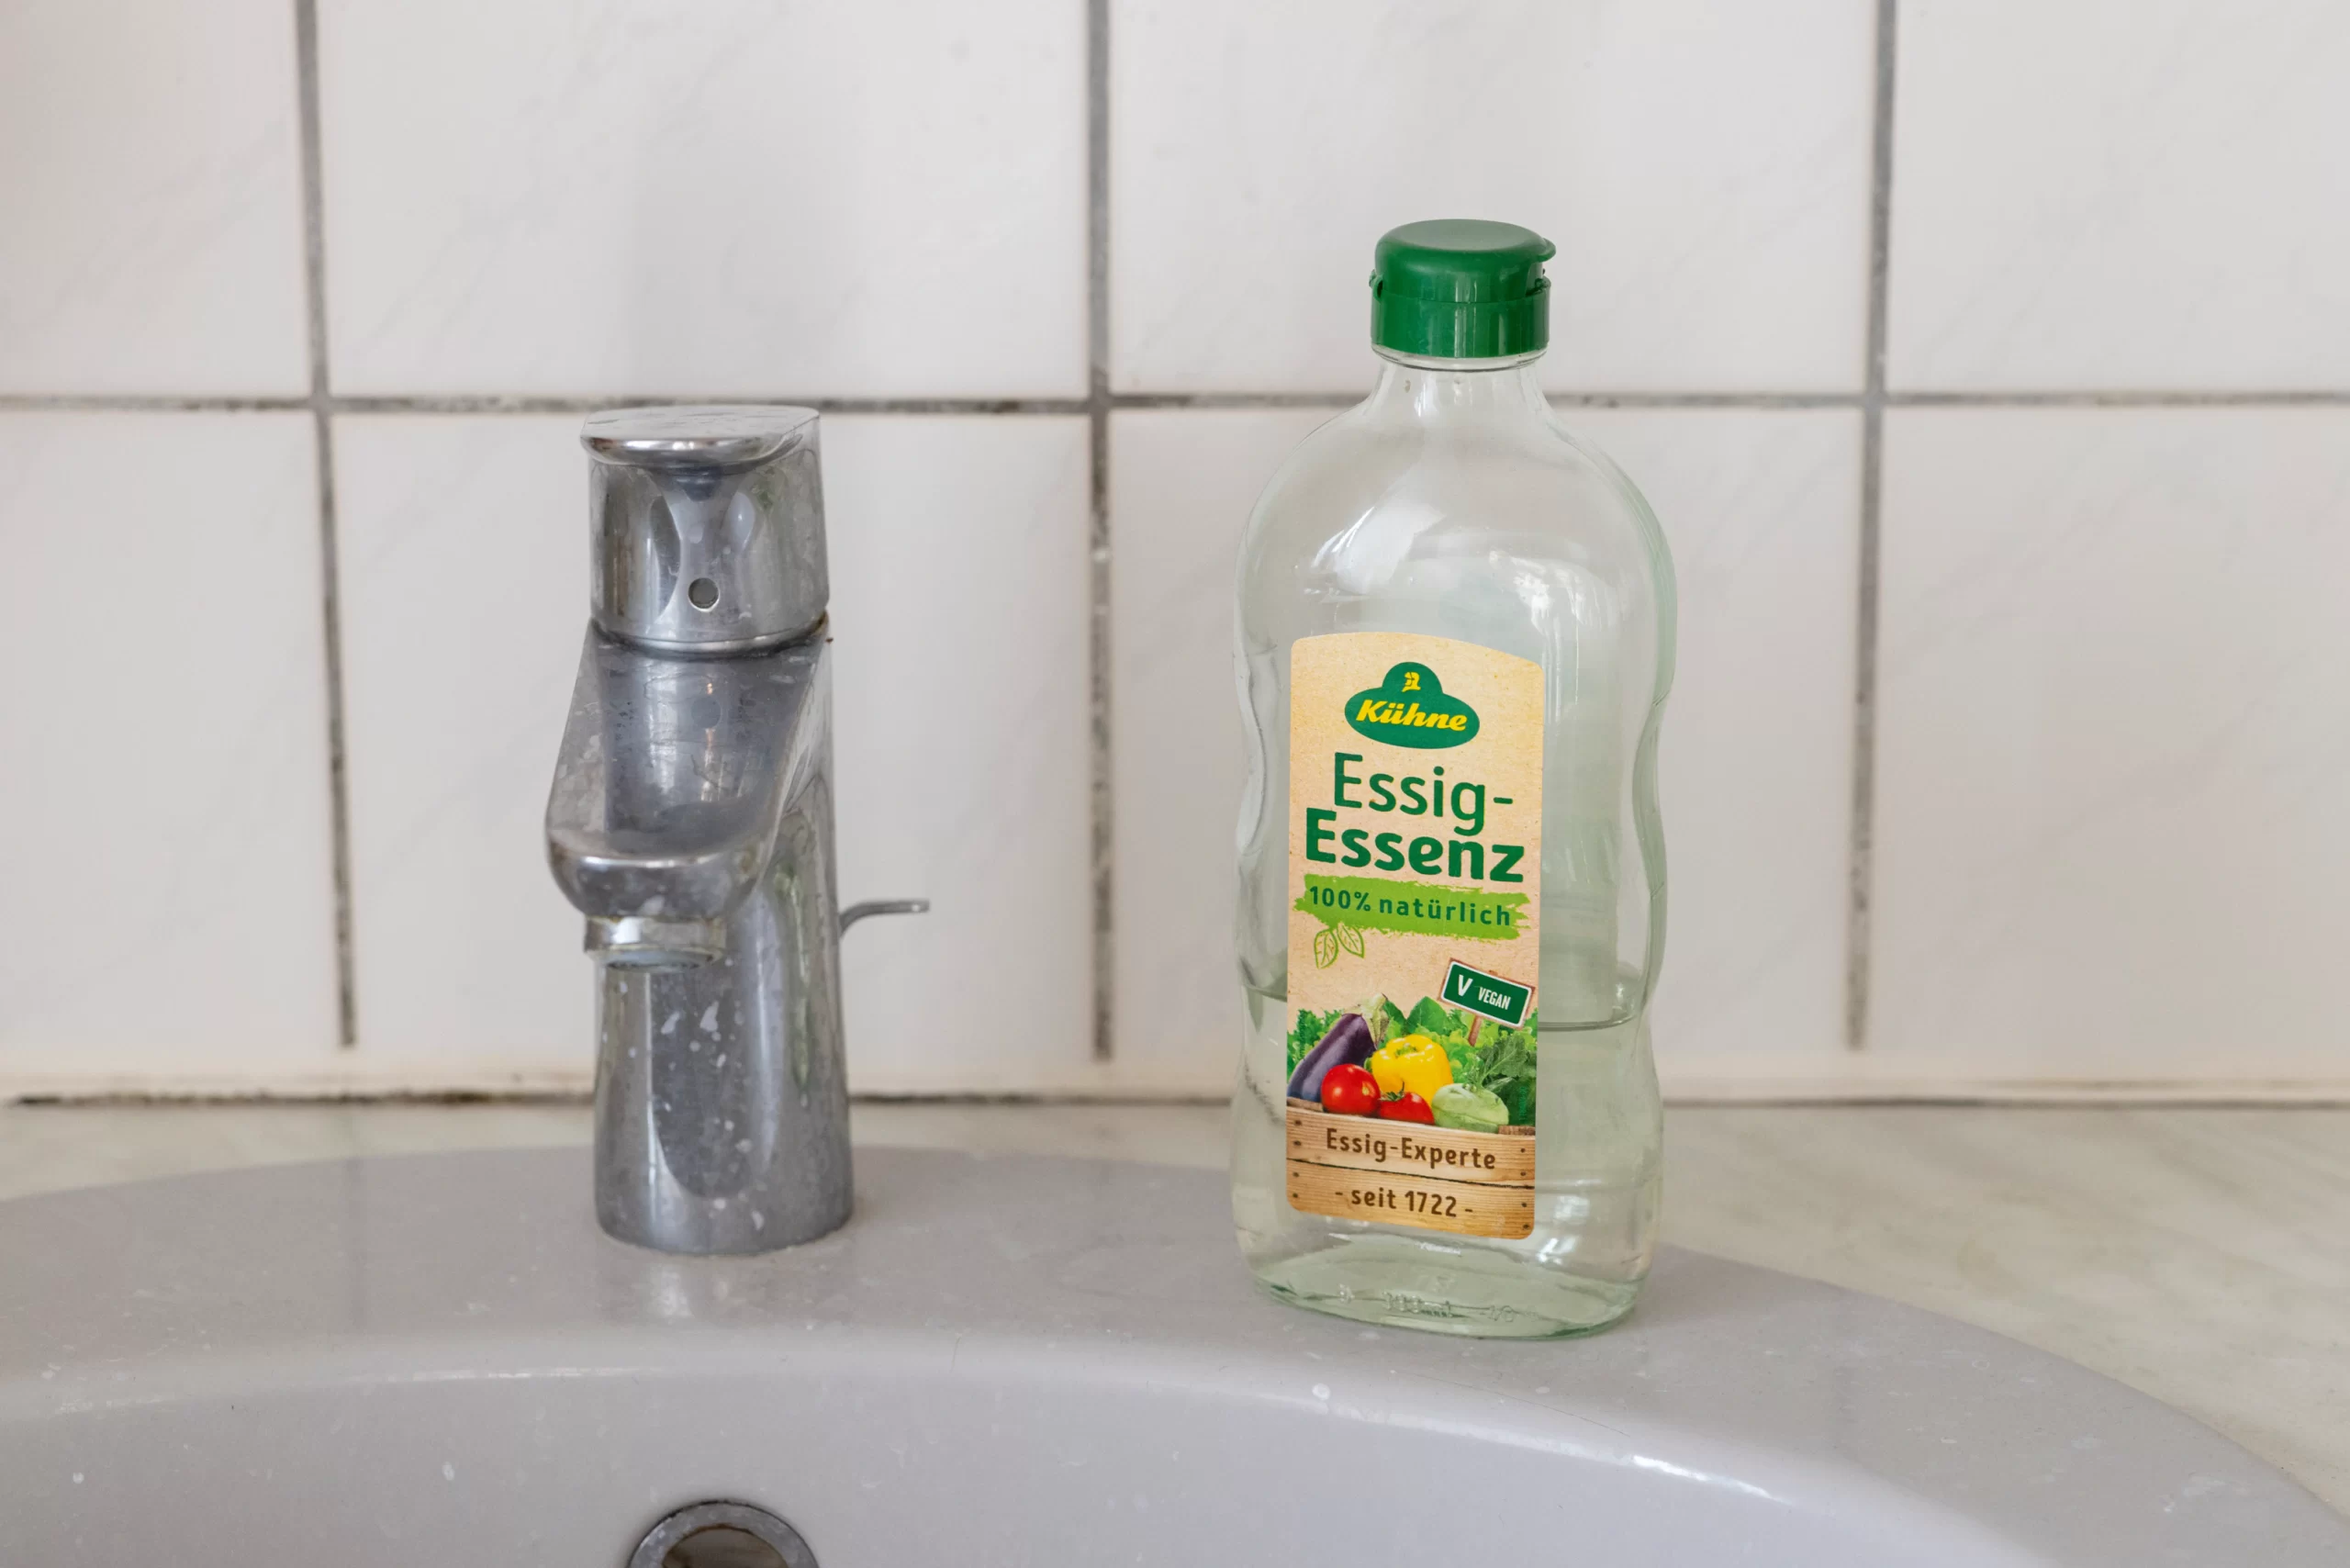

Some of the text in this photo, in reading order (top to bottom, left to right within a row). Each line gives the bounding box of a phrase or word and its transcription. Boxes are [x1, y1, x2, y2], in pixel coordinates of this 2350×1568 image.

[1355, 699, 1468, 732] Kühne
[1334, 751, 1514, 836] Essig-
[1305, 807, 1526, 883] Essenz
[1309, 885, 1511, 927] 100% natürlich
[1457, 973, 1512, 1011] V VEGAN
[1326, 1127, 1496, 1170] Essig-Experte
[1350, 1186, 1397, 1210] seit
[1404, 1190, 1458, 1218] 1722
